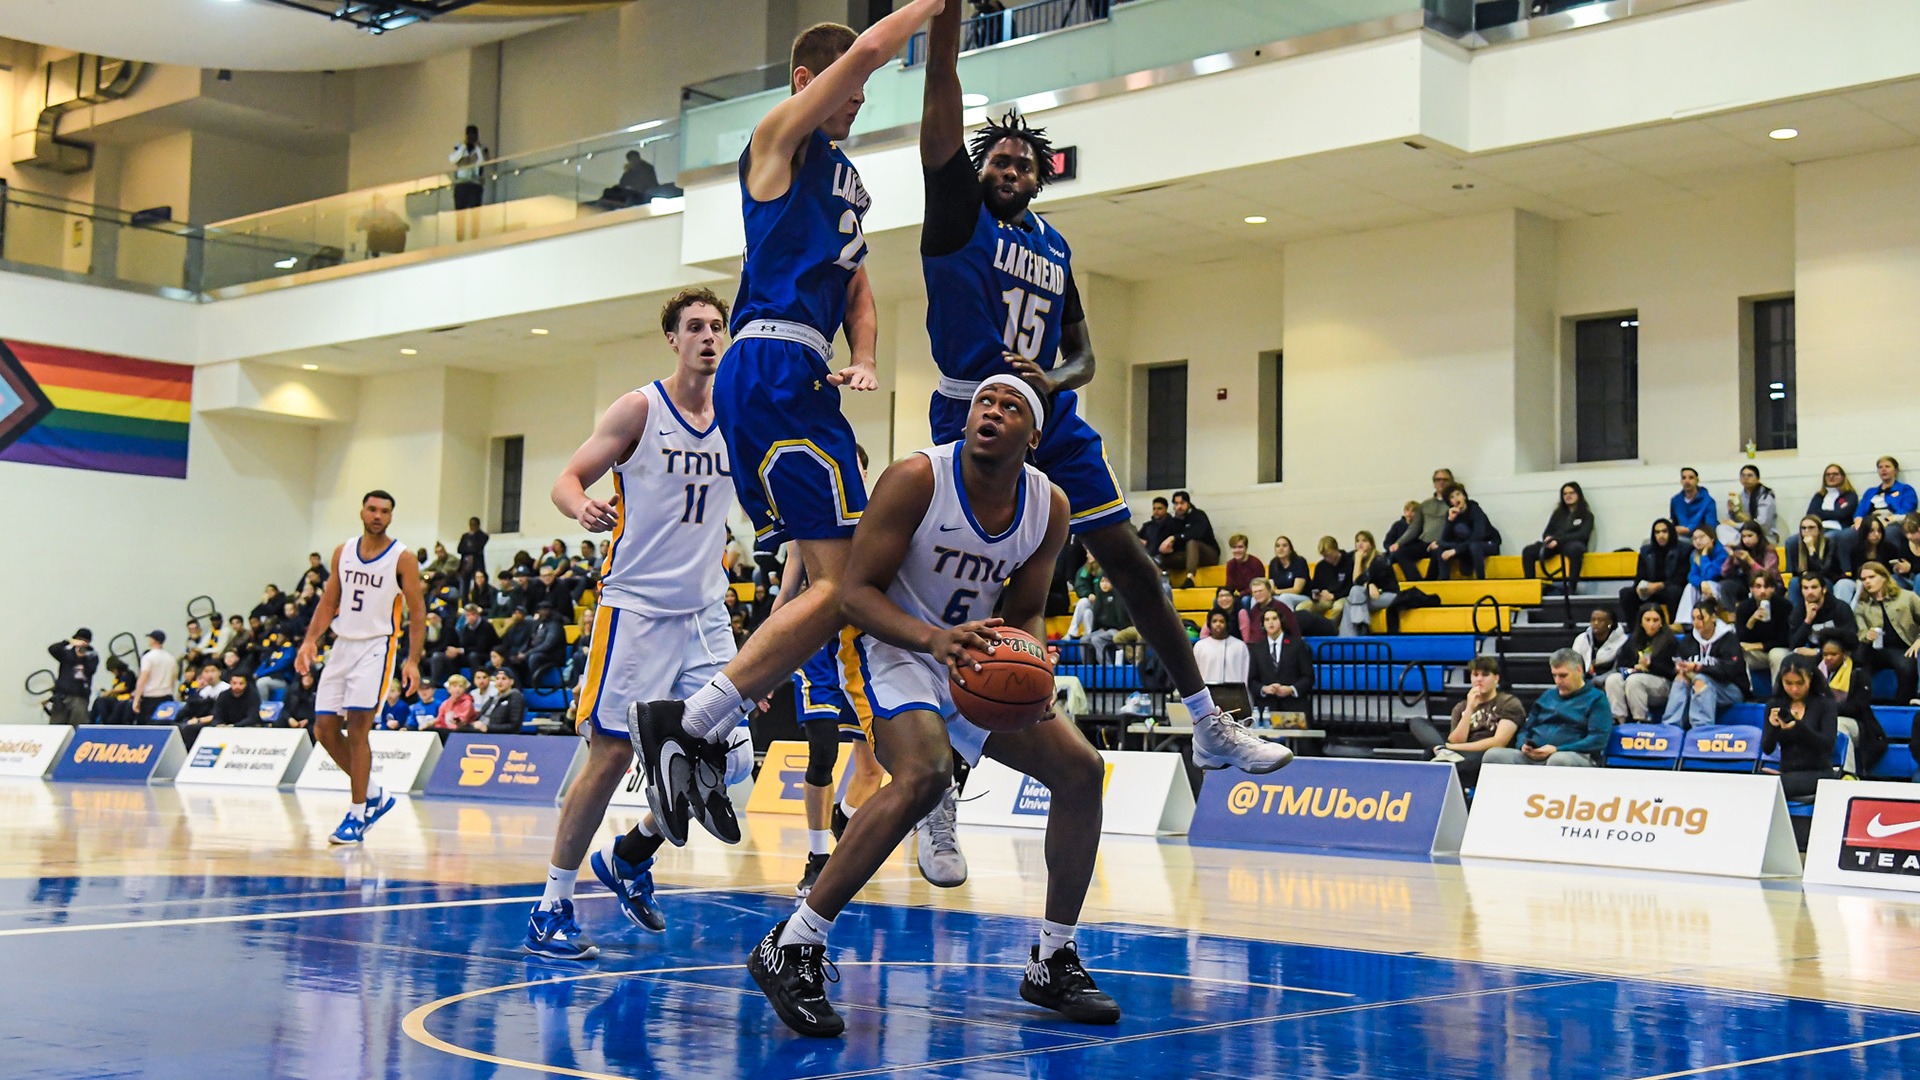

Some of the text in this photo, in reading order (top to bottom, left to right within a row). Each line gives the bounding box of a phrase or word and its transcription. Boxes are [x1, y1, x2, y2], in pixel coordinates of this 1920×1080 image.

[993, 238, 1065, 296] LAKEHEAD
[1002, 286, 1052, 361] 15
[661, 448, 732, 477] TMU
[680, 483, 710, 524] 11
[345, 570, 383, 588] TMU
[933, 545, 1020, 584] TMU
[351, 589, 364, 612] 5
[941, 588, 979, 626] 6
[74, 741, 153, 764] @TMUbold
[1621, 737, 1668, 751] BOLD
[1697, 739, 1747, 753] BOLD
[1227, 780, 1412, 823] @TMUbold
[1524, 793, 1709, 835] Salad King
[1560, 826, 1656, 843] THAI FOOD
[1855, 851, 1920, 869] TEA
